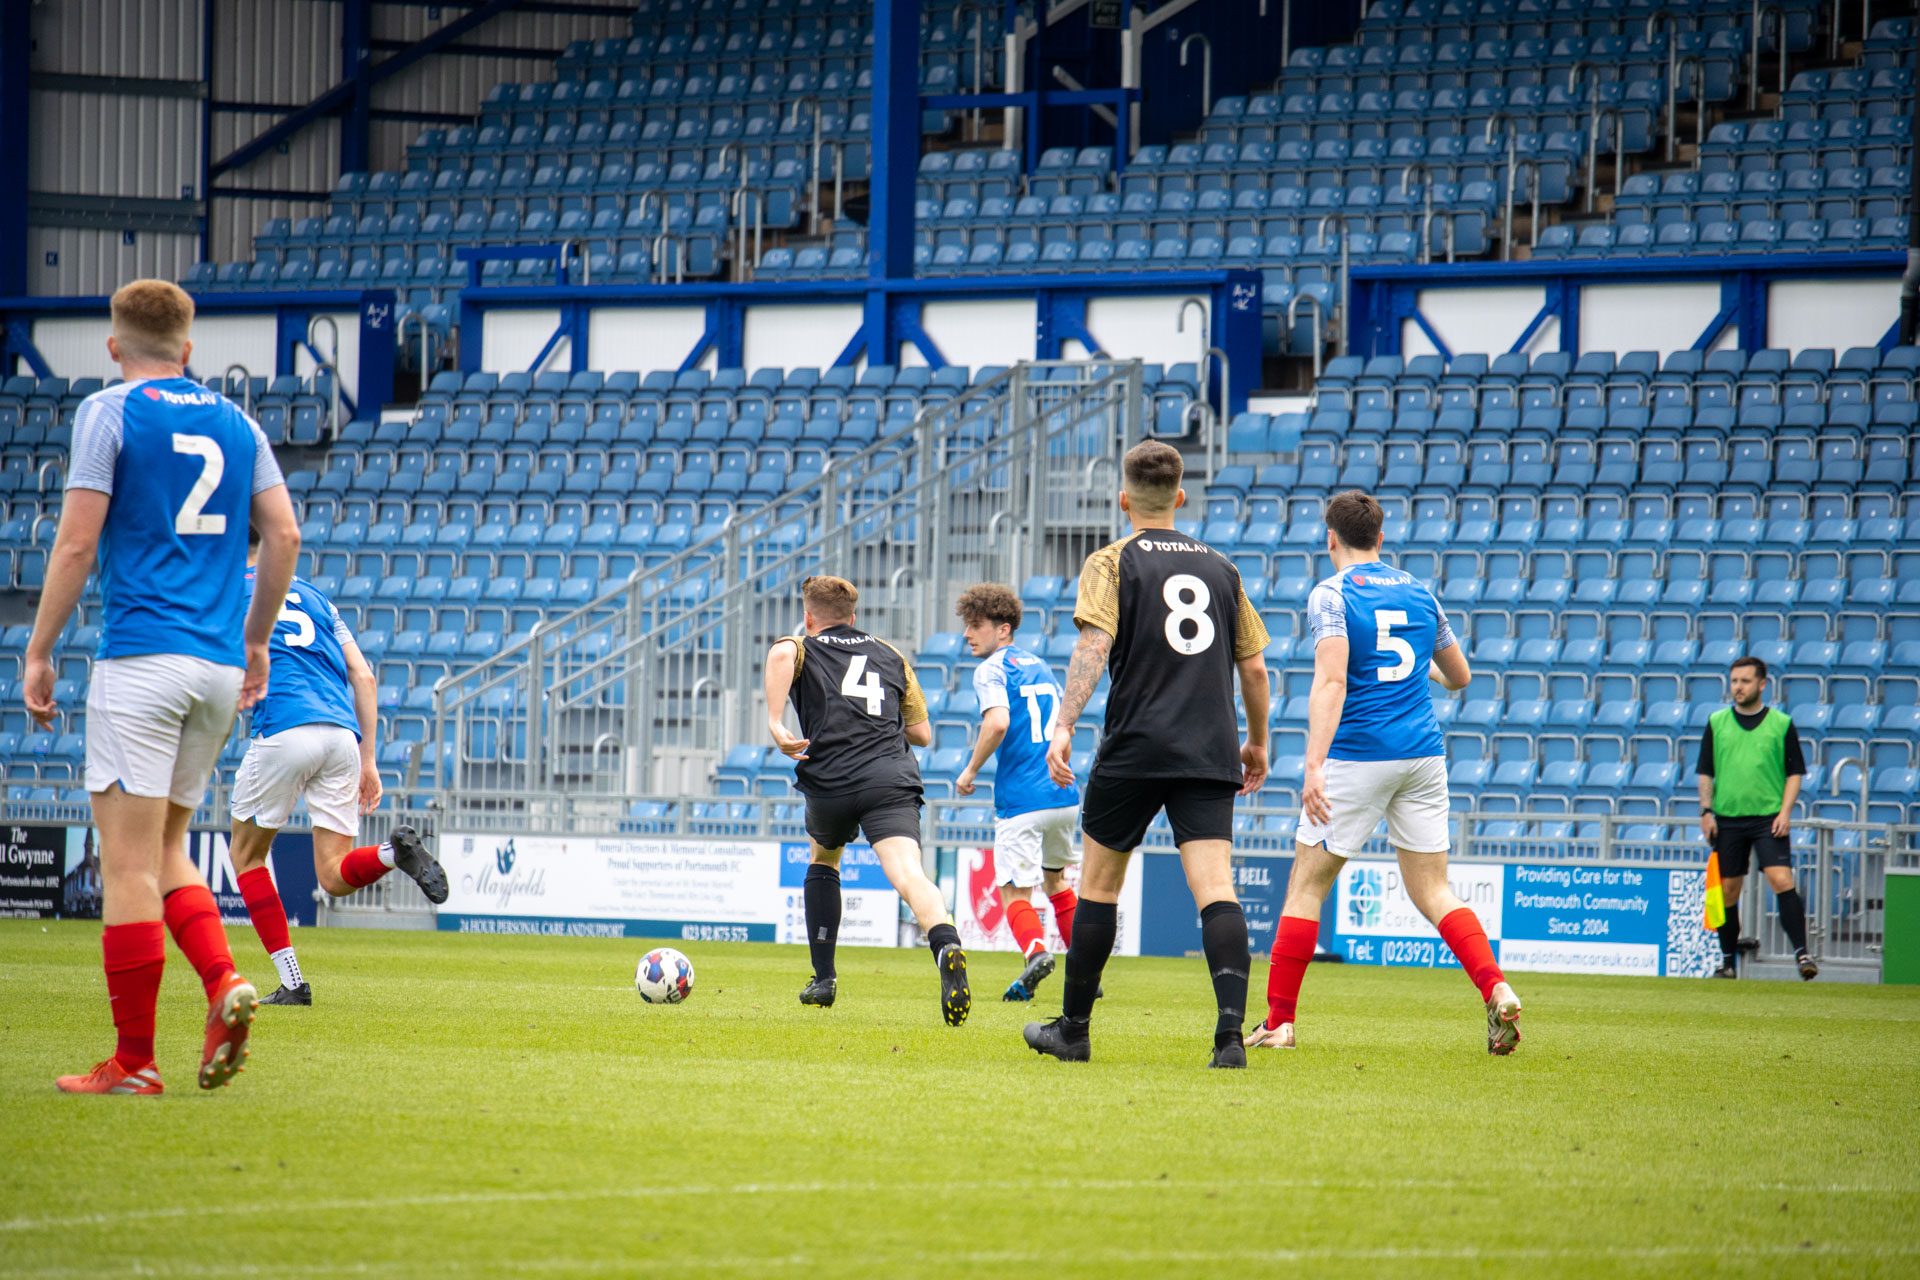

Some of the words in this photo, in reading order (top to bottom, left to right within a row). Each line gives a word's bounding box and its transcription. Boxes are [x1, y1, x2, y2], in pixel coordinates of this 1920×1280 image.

[172, 432, 226, 535] 2
[1153, 541, 1208, 554] TOTALAV
[1365, 575, 1411, 586] TOTALAV
[1162, 574, 1215, 656] 8
[1374, 609, 1416, 682] 5
[841, 654, 885, 717] 4
[1019, 683, 1060, 743] 17
[11, 827, 28, 843] The
[8, 844, 54, 870] Gwynne
[476, 863, 546, 908] Mayfields
[1239, 867, 1271, 886] BELL
[1515, 865, 1571, 888] Providing
[1572, 867, 1601, 885] Care
[1603, 868, 1620, 886] for
[1622, 869, 1643, 886] the
[1514, 890, 1581, 910] Portsmouth
[1583, 892, 1649, 916] Community
[1548, 917, 1580, 935] Since
[1582, 918, 1610, 936] 2004
[1381, 940, 1435, 968] (02392)
